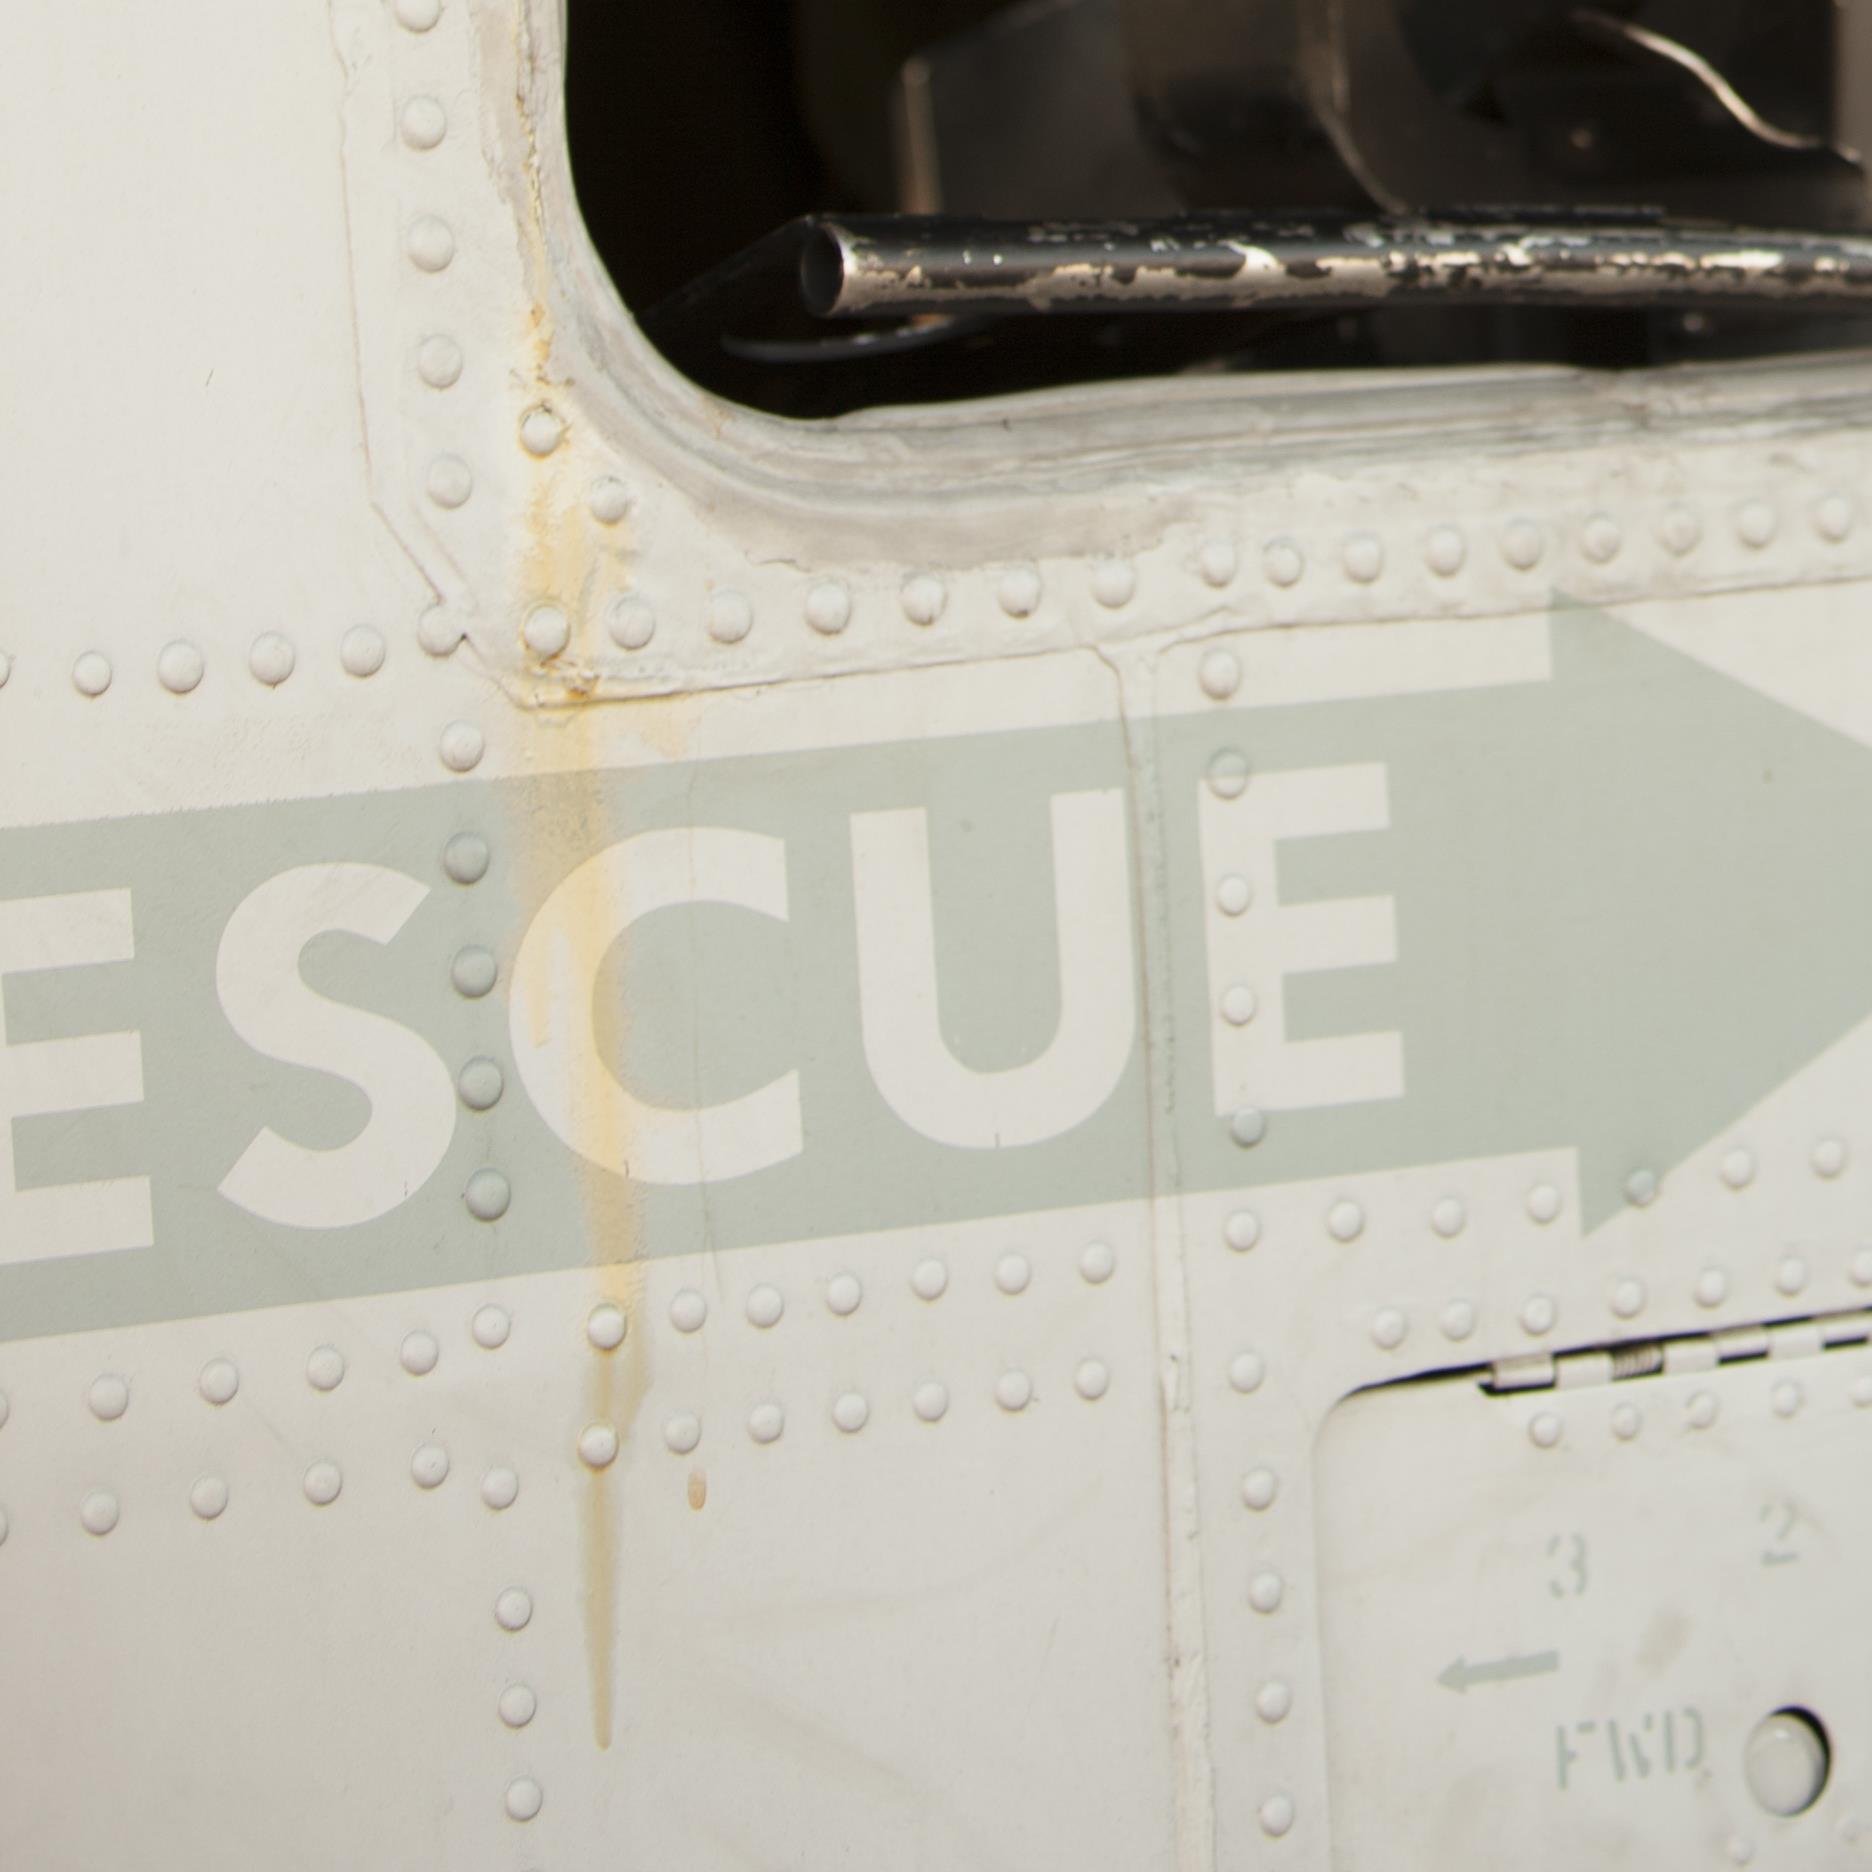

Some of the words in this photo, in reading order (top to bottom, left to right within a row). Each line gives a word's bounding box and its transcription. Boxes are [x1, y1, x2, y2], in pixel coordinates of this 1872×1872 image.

[0, 762, 1407, 1266] ESCUE
[1543, 1530, 1590, 1600] 3
[1756, 1495, 1801, 1570] 2
